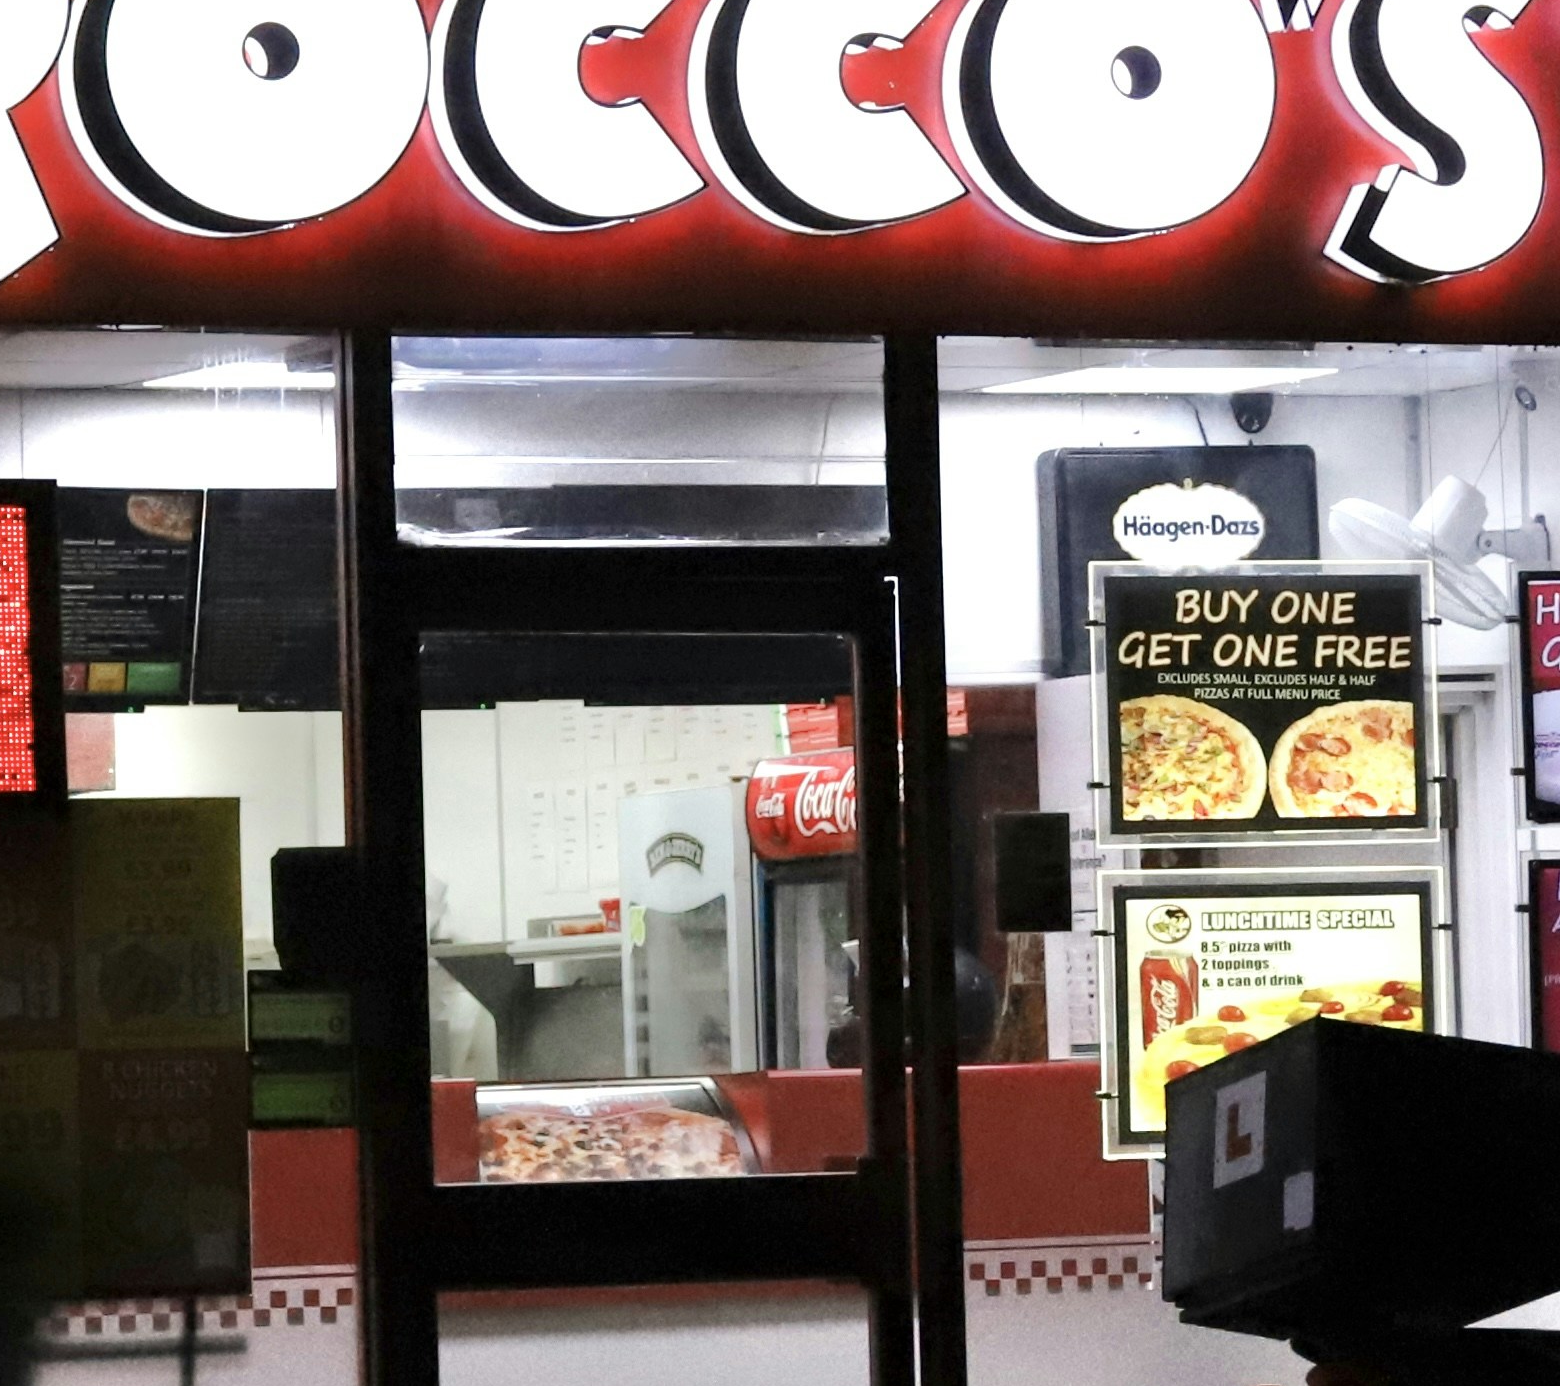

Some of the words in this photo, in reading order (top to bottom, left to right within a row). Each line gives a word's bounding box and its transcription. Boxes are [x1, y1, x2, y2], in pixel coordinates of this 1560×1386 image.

[1175, 589, 1259, 624] BUY
[1270, 590, 1356, 625] ONE
[1117, 631, 1202, 669] GET
[1212, 633, 1298, 668] ONE
[1314, 635, 1413, 669] FREE
[1157, 673, 1211, 685] EXCLUDES
[1213, 673, 1252, 686] SMALL,
[1254, 674, 1307, 686] EXCLUDES
[1309, 674, 1336, 686] HALF
[1339, 675, 1347, 686] &
[1349, 675, 1377, 686] HALF
[1194, 688, 1230, 699] PIZZAS
[1231, 688, 1245, 699] AT
[1247, 688, 1274, 700] FULL
[1275, 688, 1309, 700] MENU
[1310, 689, 1341, 700] PRICE
[794, 765, 856, 837] Coca-Co
[1200, 911, 1312, 931] LUNCHTIME
[1316, 909, 1395, 929] SPECIAL
[1228, 940, 1261, 954] pizza
[1263, 939, 1292, 952] with
[1201, 958, 1208, 971] 2
[1211, 957, 1270, 972] toppings
[1216, 977, 1224, 987] a
[1227, 976, 1252, 987] can
[1254, 975, 1267, 987] of
[1269, 974, 1304, 986] drink
[1226, 1102, 1252, 1163] L
